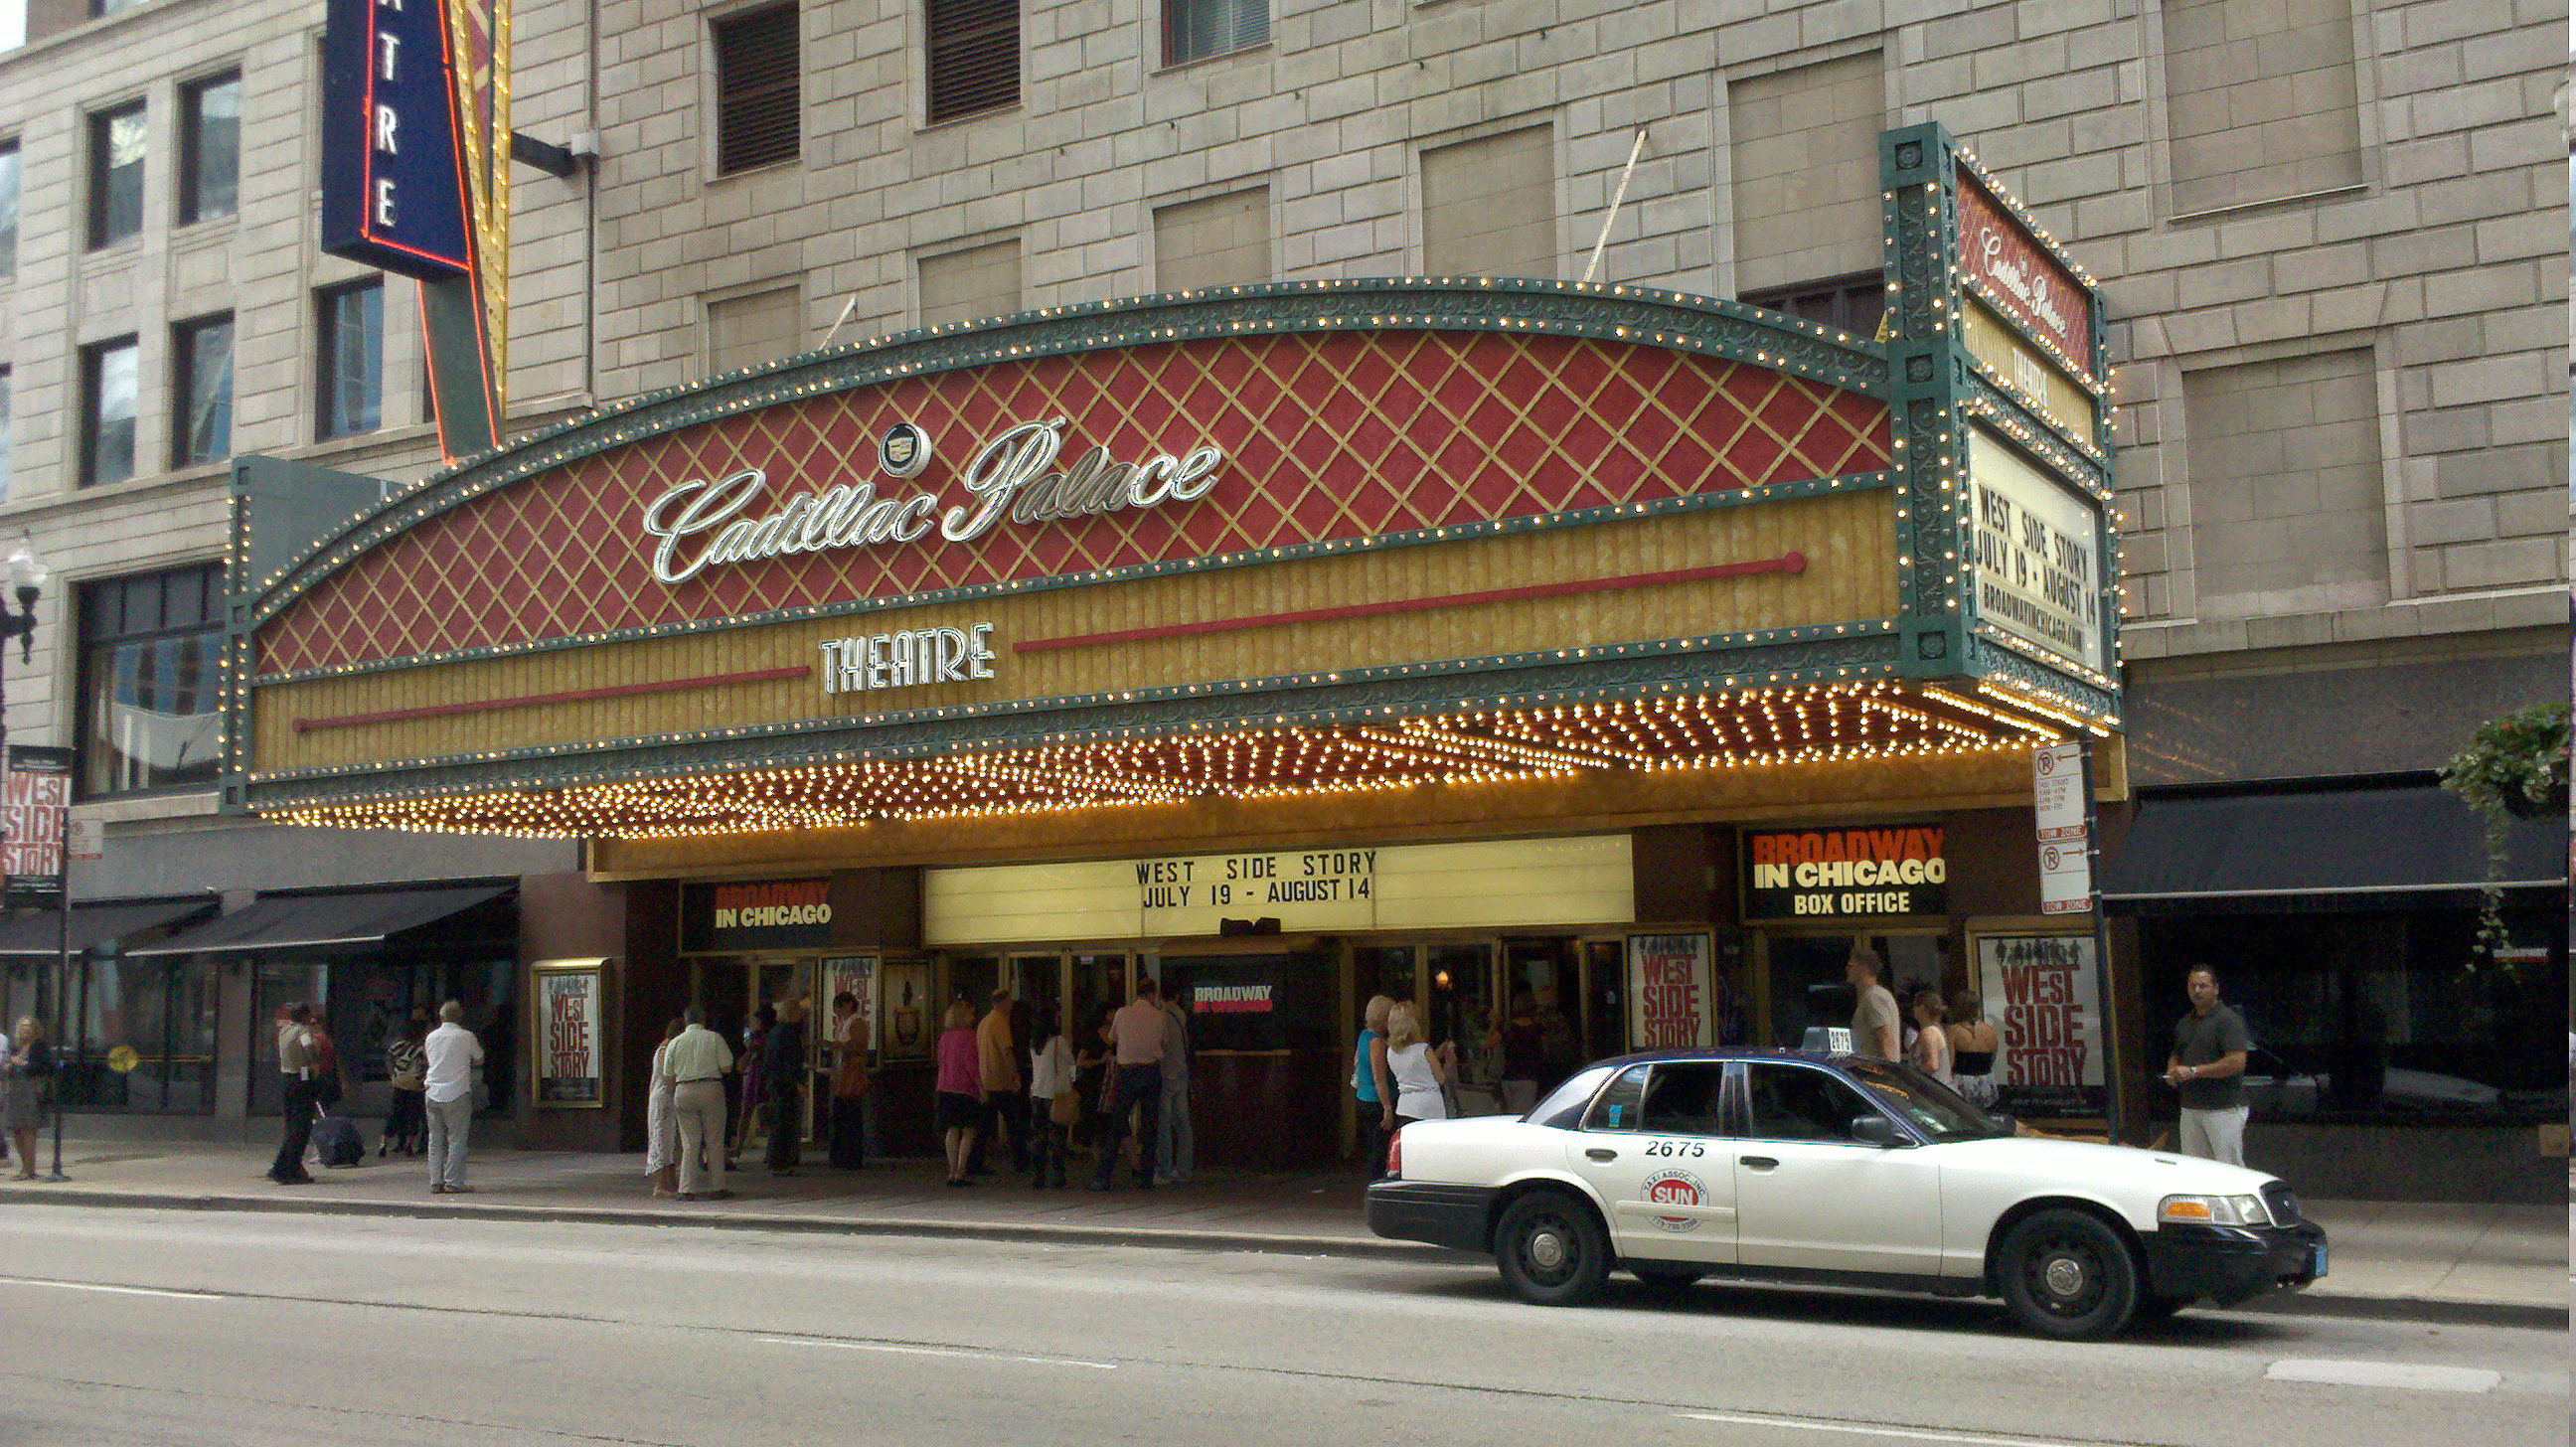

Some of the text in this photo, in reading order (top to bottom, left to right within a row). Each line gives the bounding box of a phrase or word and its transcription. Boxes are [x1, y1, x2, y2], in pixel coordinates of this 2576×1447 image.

[378, 0, 401, 228] TRE
[643, 414, 1222, 584] Cadillac Palace
[1979, 483, 2087, 582] WEST SIDE STORY
[1976, 529, 2008, 579] JULY
[2014, 548, 2027, 588] 19
[2043, 564, 2081, 618] AUGUST
[2085, 590, 2096, 627] 14
[819, 622, 996, 694] THEATRE
[8, 771, 72, 806] WEST
[1753, 828, 1944, 866] BROADWAY
[1136, 851, 1377, 884] WEST SIDE STORY
[1754, 858, 1946, 888] IN CHICAGO
[1144, 885, 1191, 908] JULY
[1210, 884, 1231, 905] 19
[1267, 879, 1341, 903] AUGUST
[1349, 877, 1369, 899] 14
[1794, 891, 1910, 915] BOX OFFICE
[716, 903, 832, 928] IN CHICAGO
[1640, 953, 1698, 985] WEST
[2002, 963, 2080, 1005] WEST
[551, 995, 588, 1022] WEST
[1195, 985, 1272, 1002] BROADWAY
[1643, 985, 1700, 1019] SIDE
[551, 1022, 589, 1051] SIDE
[1645, 1018, 1701, 1048] STORY
[2004, 1004, 2085, 1047] SIDE
[551, 1051, 589, 1078] STORY
[2007, 1046, 2086, 1086] STORY
[1645, 1140, 1705, 1158] 2675
[1655, 1187, 1694, 1206] SUN
